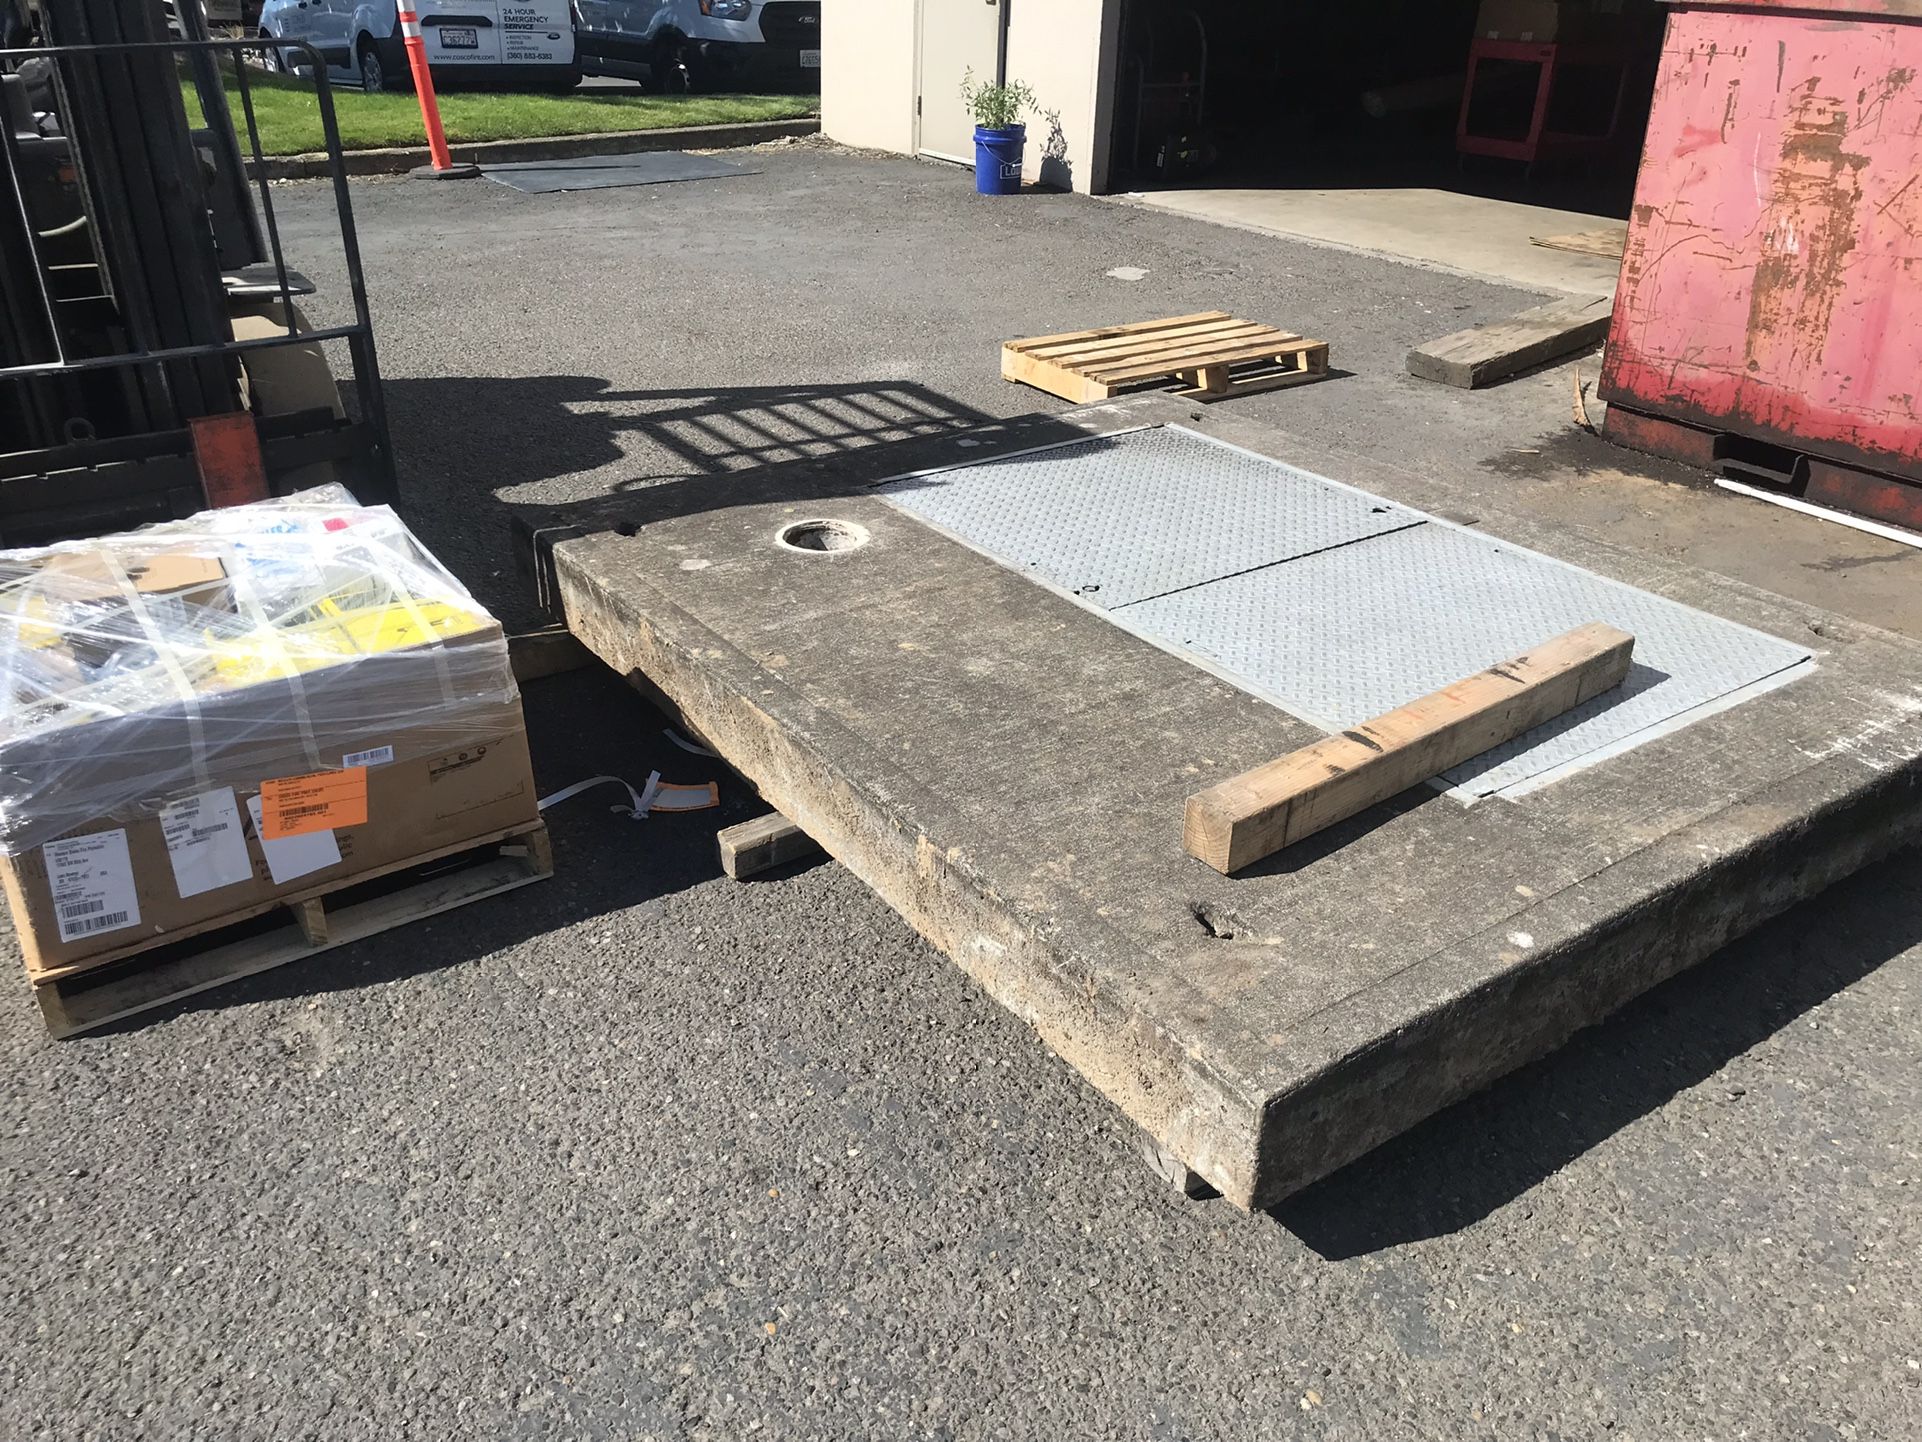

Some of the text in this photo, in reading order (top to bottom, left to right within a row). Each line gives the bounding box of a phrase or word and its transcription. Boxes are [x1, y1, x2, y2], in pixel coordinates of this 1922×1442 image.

[514, 8, 536, 16] HOUR
[503, 15, 549, 24] EMERGENCY
[503, 23, 535, 31] SERVICE
